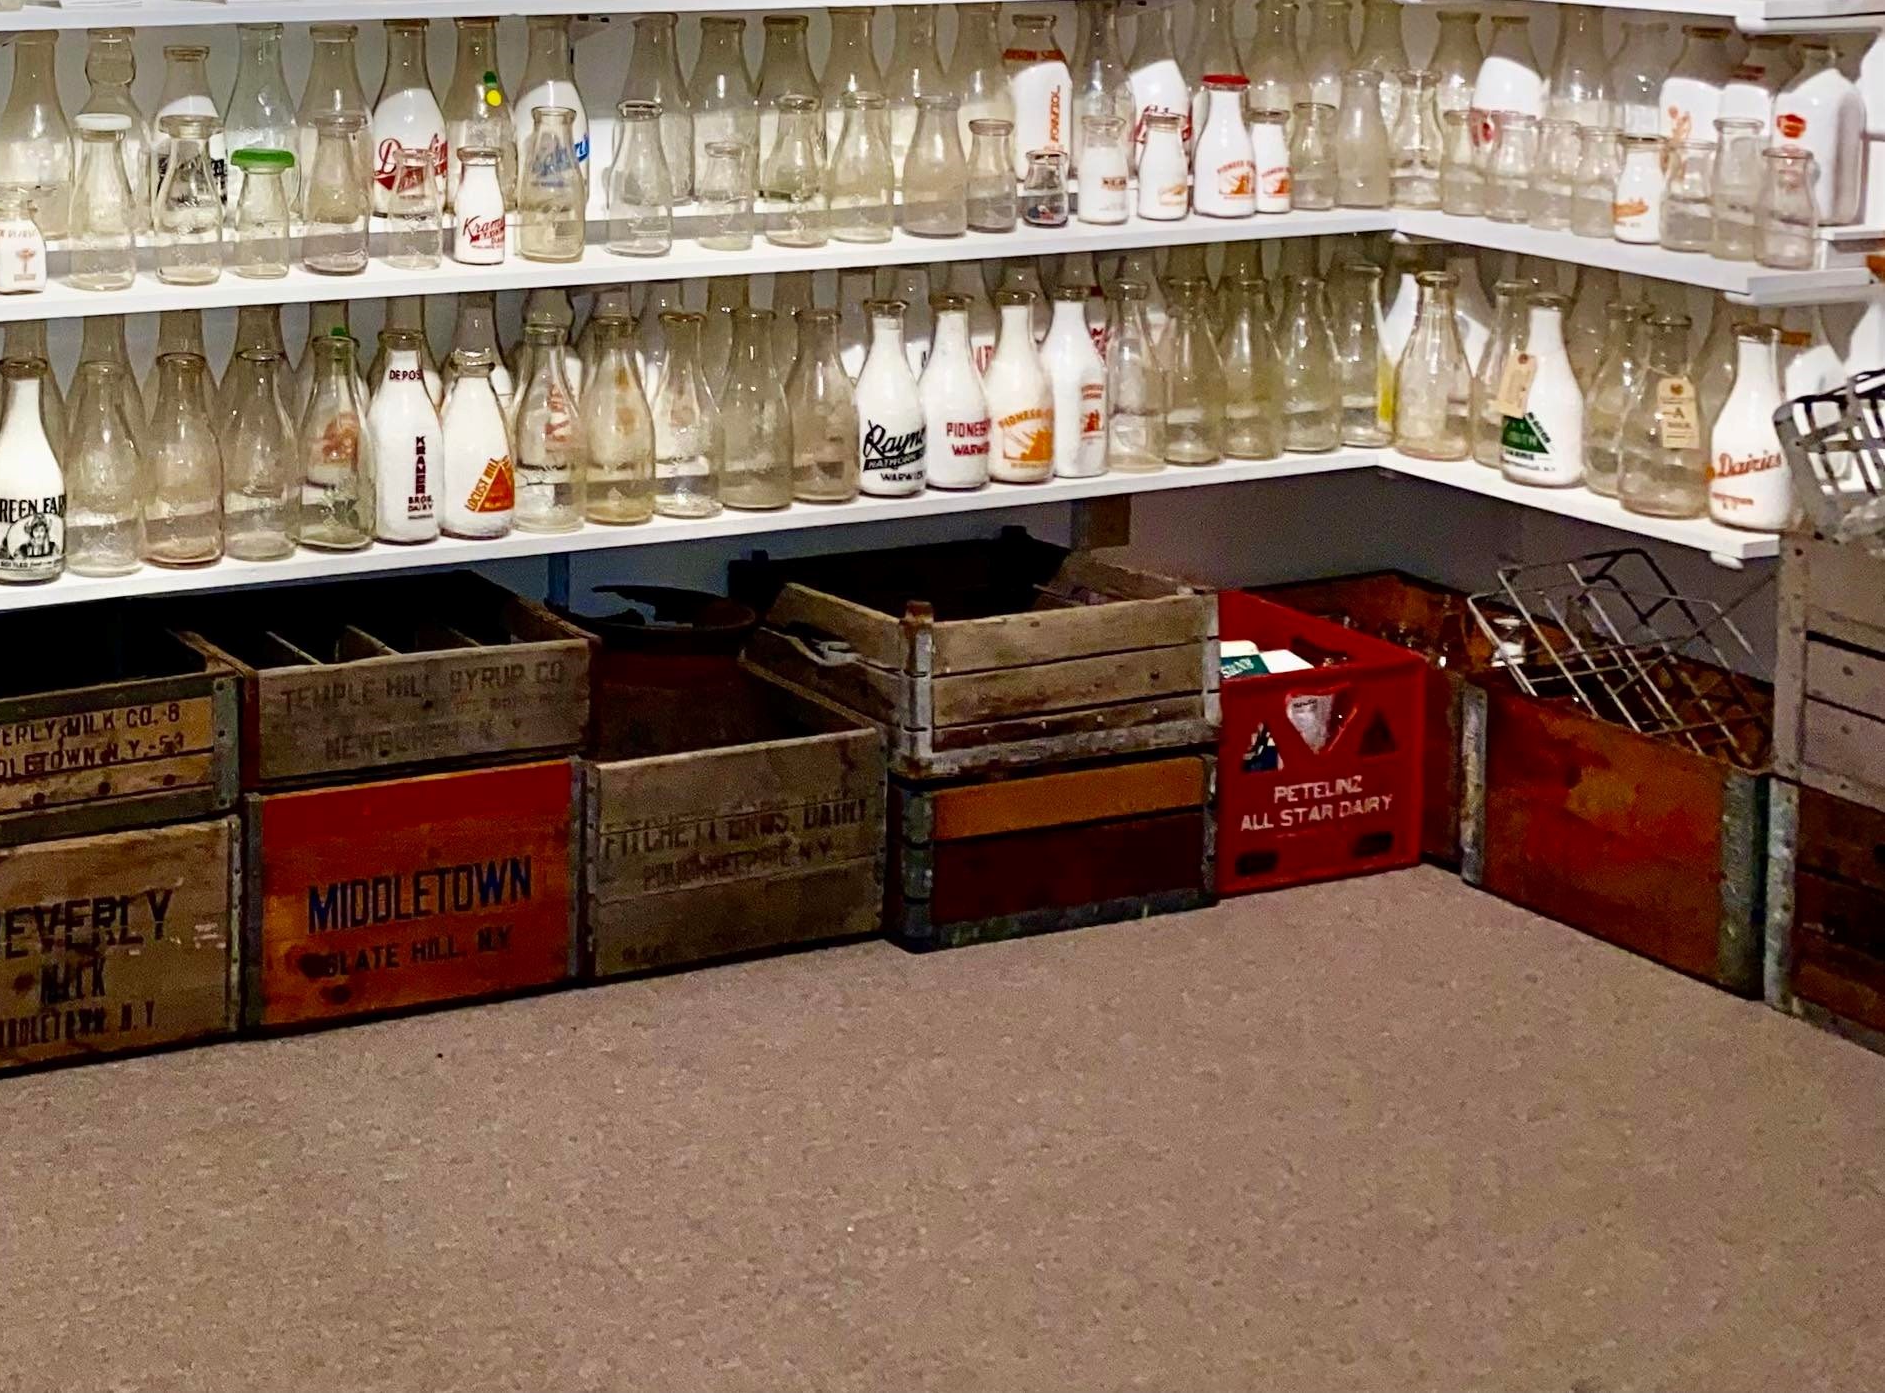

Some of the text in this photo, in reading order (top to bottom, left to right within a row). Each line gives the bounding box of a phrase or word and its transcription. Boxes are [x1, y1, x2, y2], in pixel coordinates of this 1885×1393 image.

[1273, 775, 1364, 805] PETELINZ
[1240, 793, 1394, 833] ALL STAR DAIRY
[307, 854, 532, 936] MIDDLETOWN
[411, 933, 459, 963] HILL
